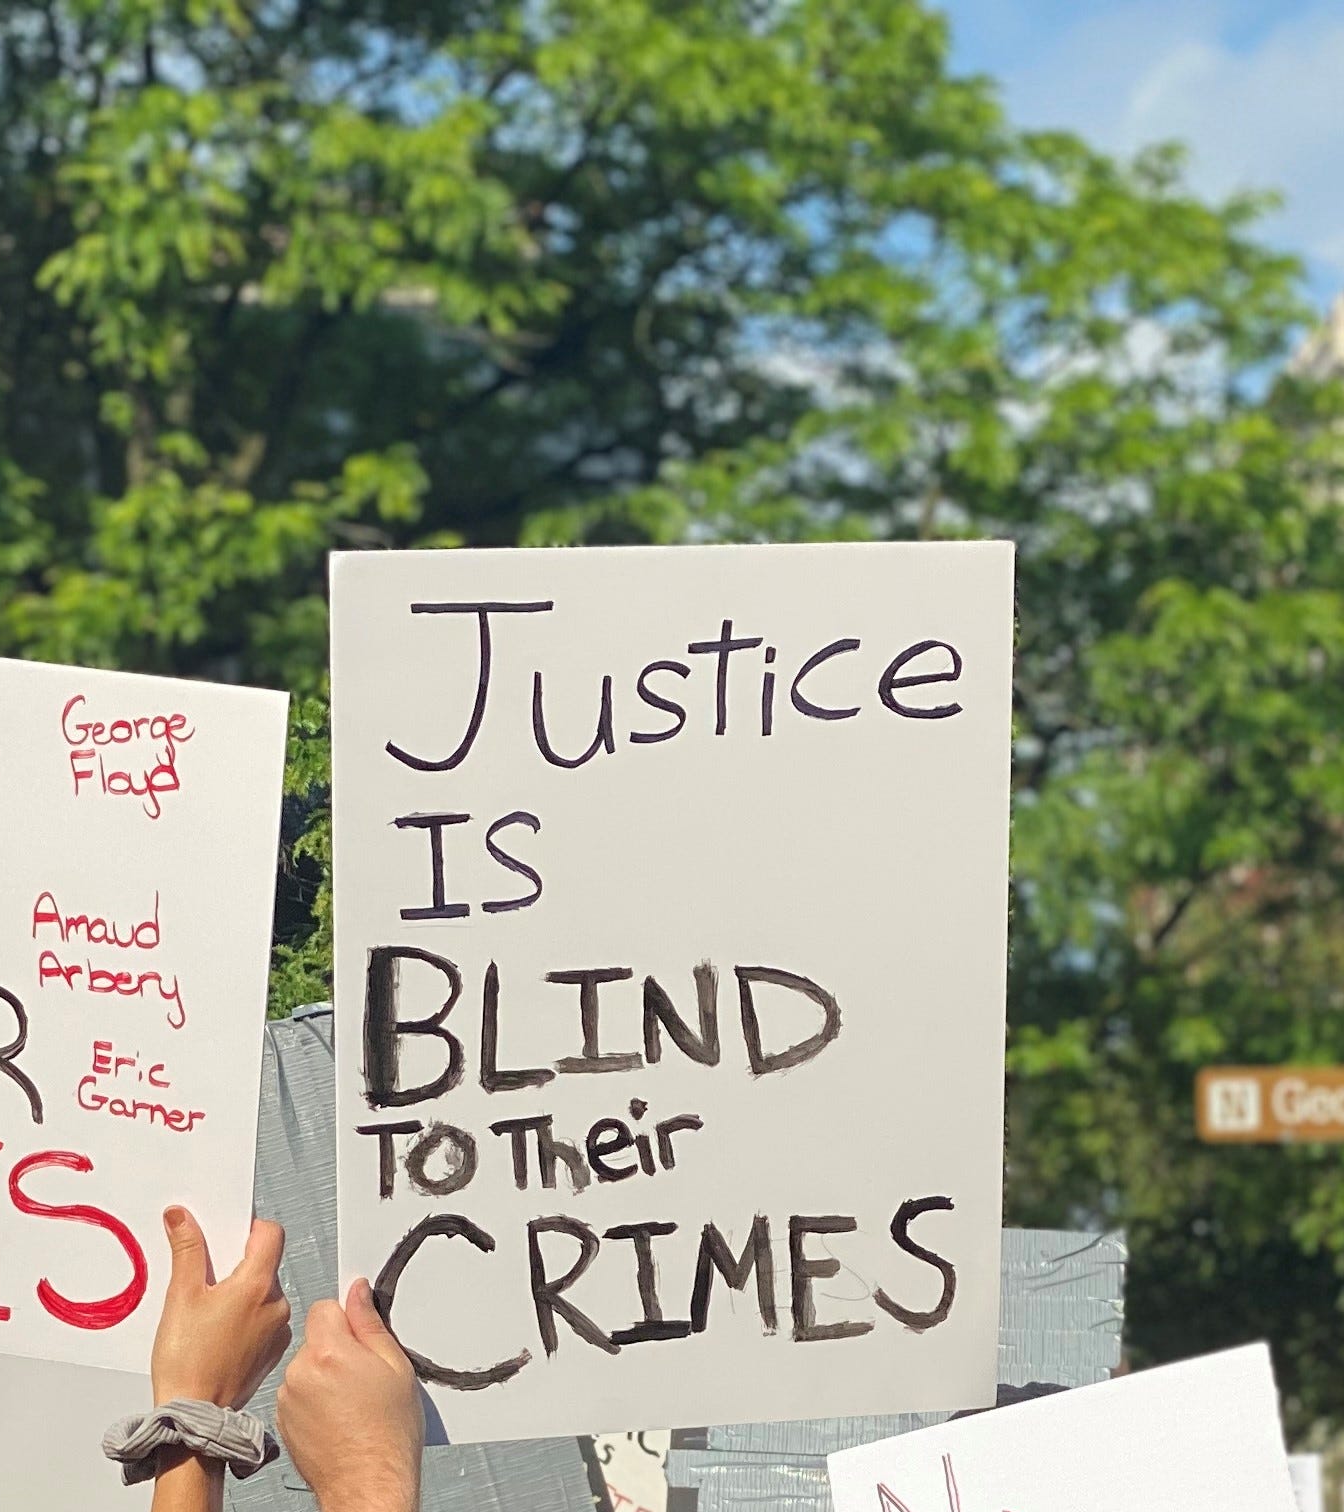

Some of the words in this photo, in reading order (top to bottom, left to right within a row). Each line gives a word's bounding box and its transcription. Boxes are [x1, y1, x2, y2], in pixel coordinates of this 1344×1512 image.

[62, 695, 196, 765] George
[386, 600, 963, 772] Justice
[70, 745, 180, 820] Floyd
[389, 811, 545, 920] IS
[39, 950, 185, 1030] Arbery
[358, 945, 843, 1110] BLIND
[77, 1076, 205, 1132] Garner
[92, 1041, 171, 1088] Eric
[356, 1119, 479, 1200] TO
[489, 1097, 704, 1195] Their
[371, 1196, 959, 1391] CRIMES
